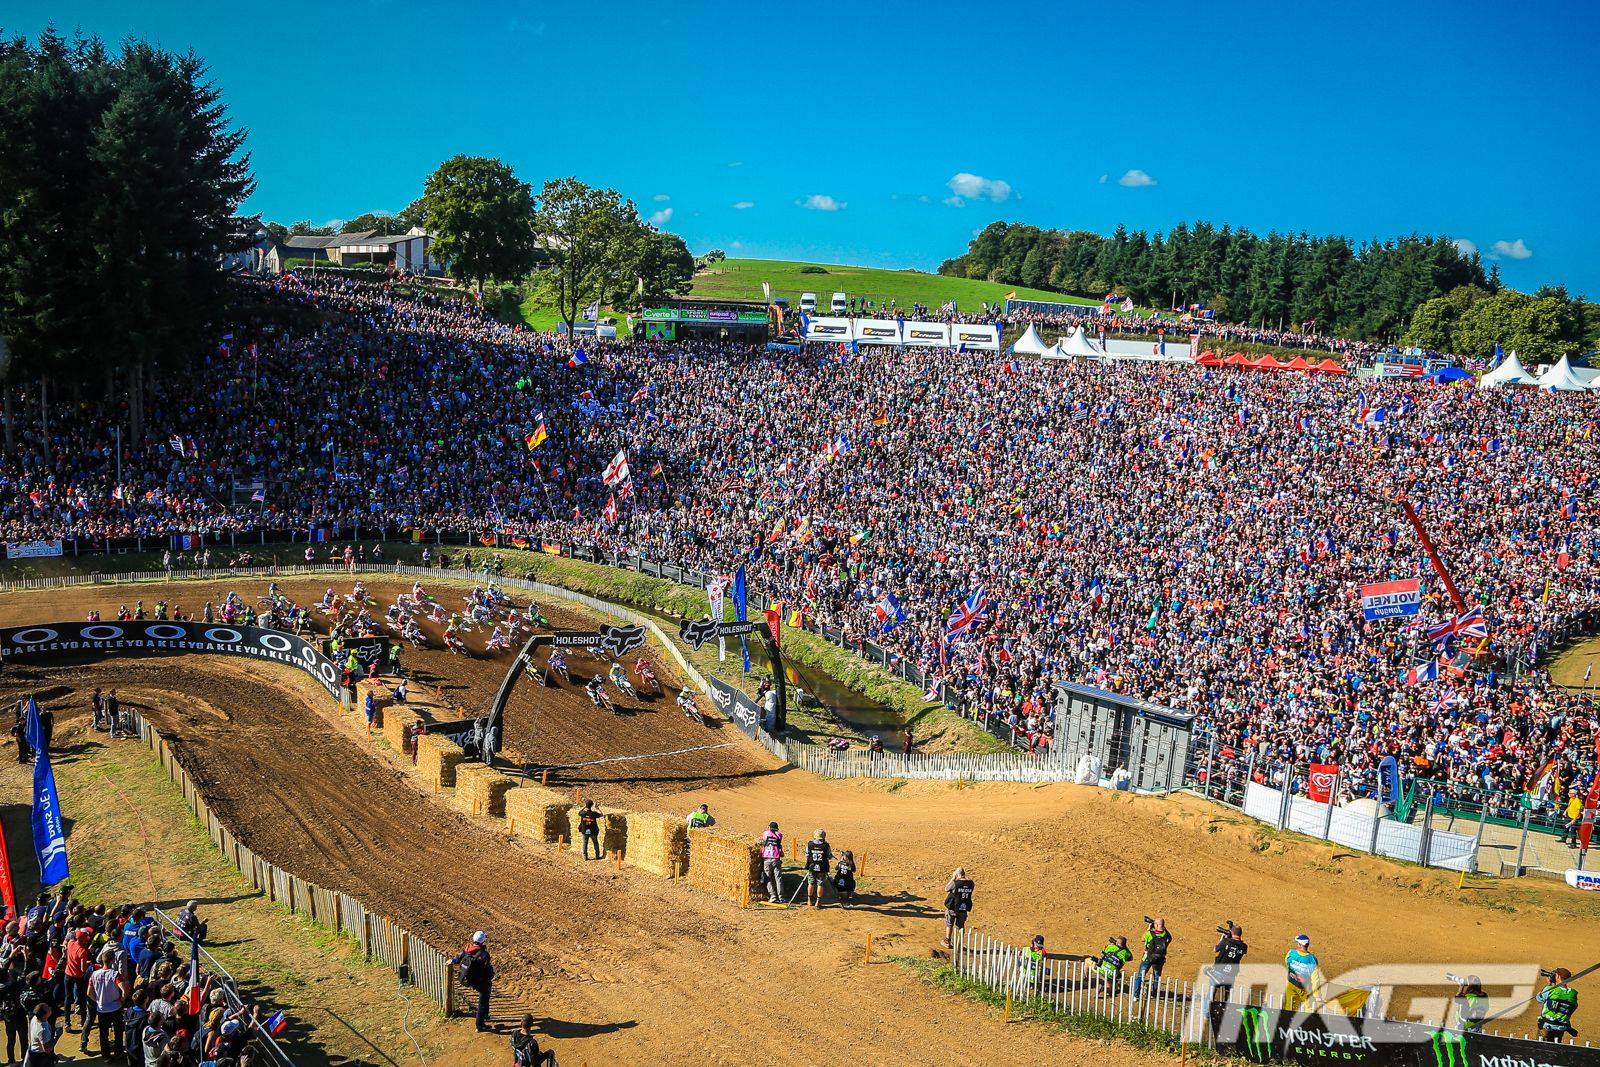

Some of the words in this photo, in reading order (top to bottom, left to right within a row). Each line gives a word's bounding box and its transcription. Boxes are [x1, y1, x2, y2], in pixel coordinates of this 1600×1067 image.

[720, 625, 752, 634] HOLESHOT
[556, 636, 600, 645] HOLESHOT
[2, 642, 70, 656] OAKLEY
[70, 639, 136, 649] OAKLEY
[136, 639, 197, 649] OAKLEY
[197, 641, 252, 653] OAKLEY
[251, 648, 298, 664] OAKLEY
[1279, 1027, 1377, 1051] MONSTER
[1295, 1047, 1364, 1061] ENERGY
